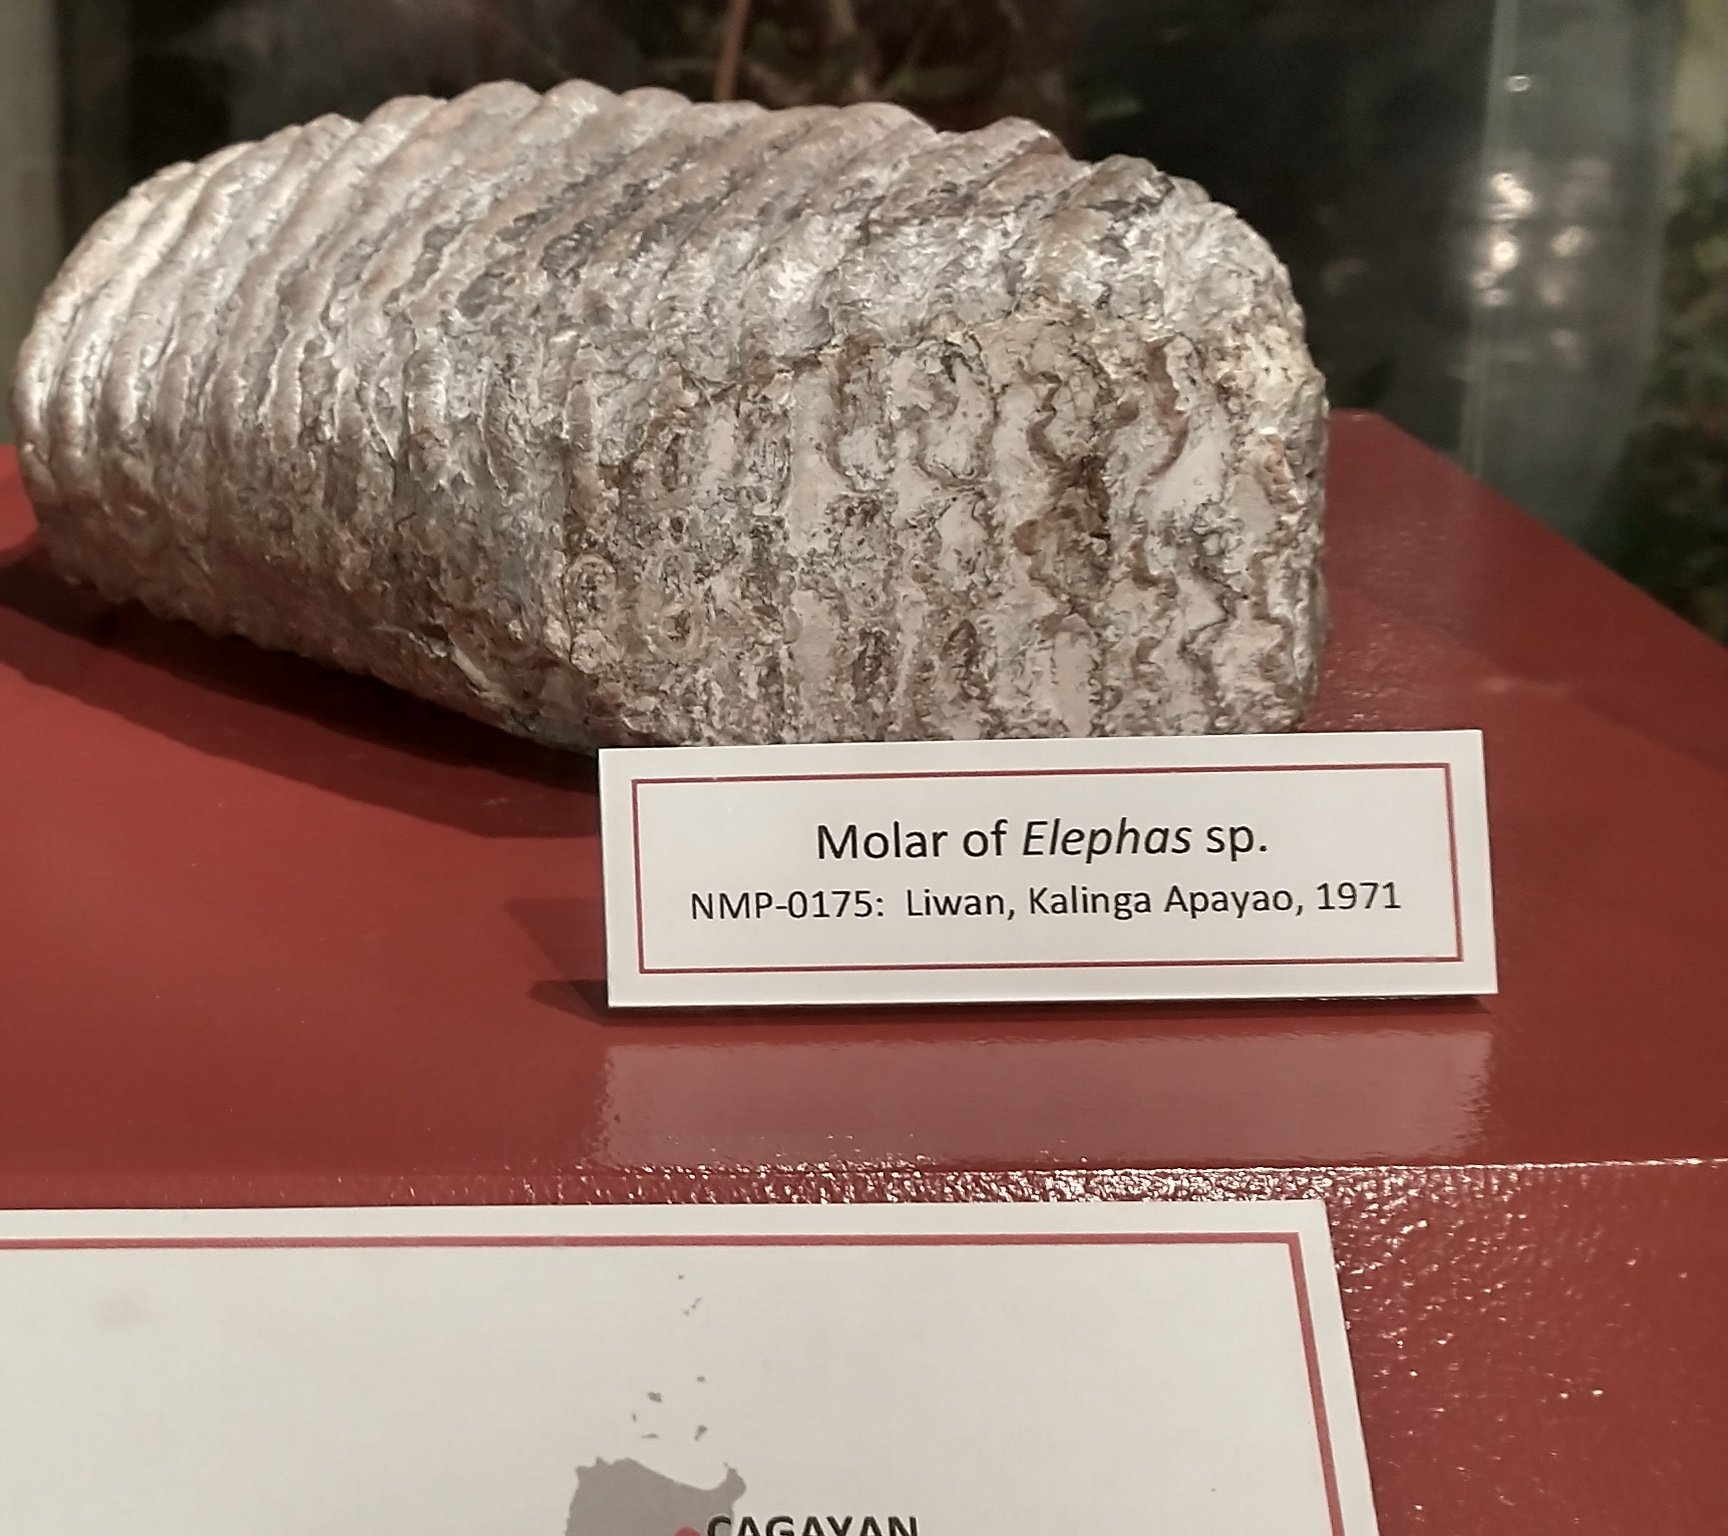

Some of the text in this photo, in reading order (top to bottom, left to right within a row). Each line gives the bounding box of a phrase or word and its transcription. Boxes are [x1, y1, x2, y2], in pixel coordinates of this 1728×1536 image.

[817, 816, 1268, 864] Molar of Elephas sp.
[691, 881, 1401, 921] NMP-0175: Liwan, Kalinga Apayao, 1971
